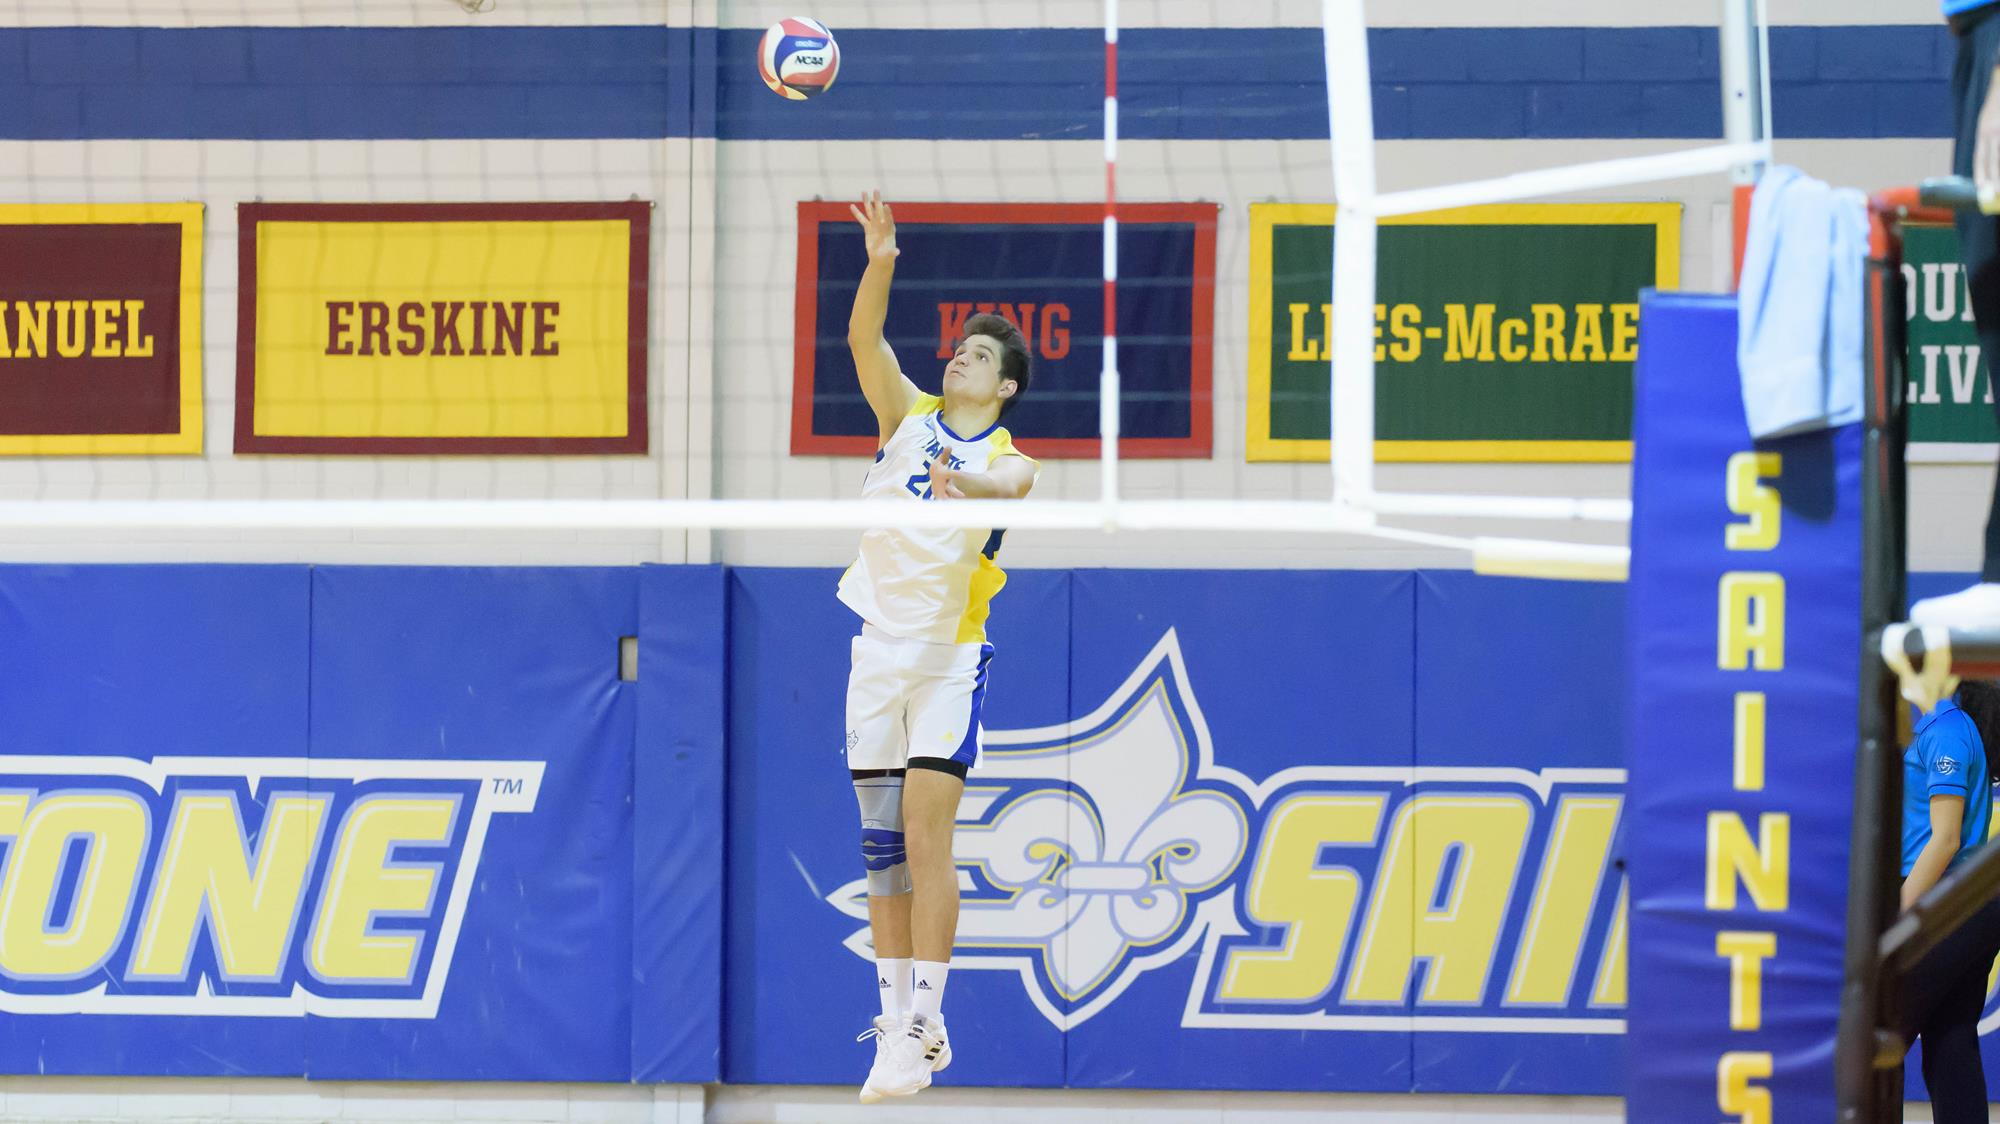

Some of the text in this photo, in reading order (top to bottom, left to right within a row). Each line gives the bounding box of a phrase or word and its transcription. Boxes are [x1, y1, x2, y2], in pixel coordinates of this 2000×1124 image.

[325, 301, 560, 356] ERSKINE
[936, 302, 1071, 360] KNG
[0, 788, 464, 985] ONE
[1213, 791, 1628, 1008] SAI
